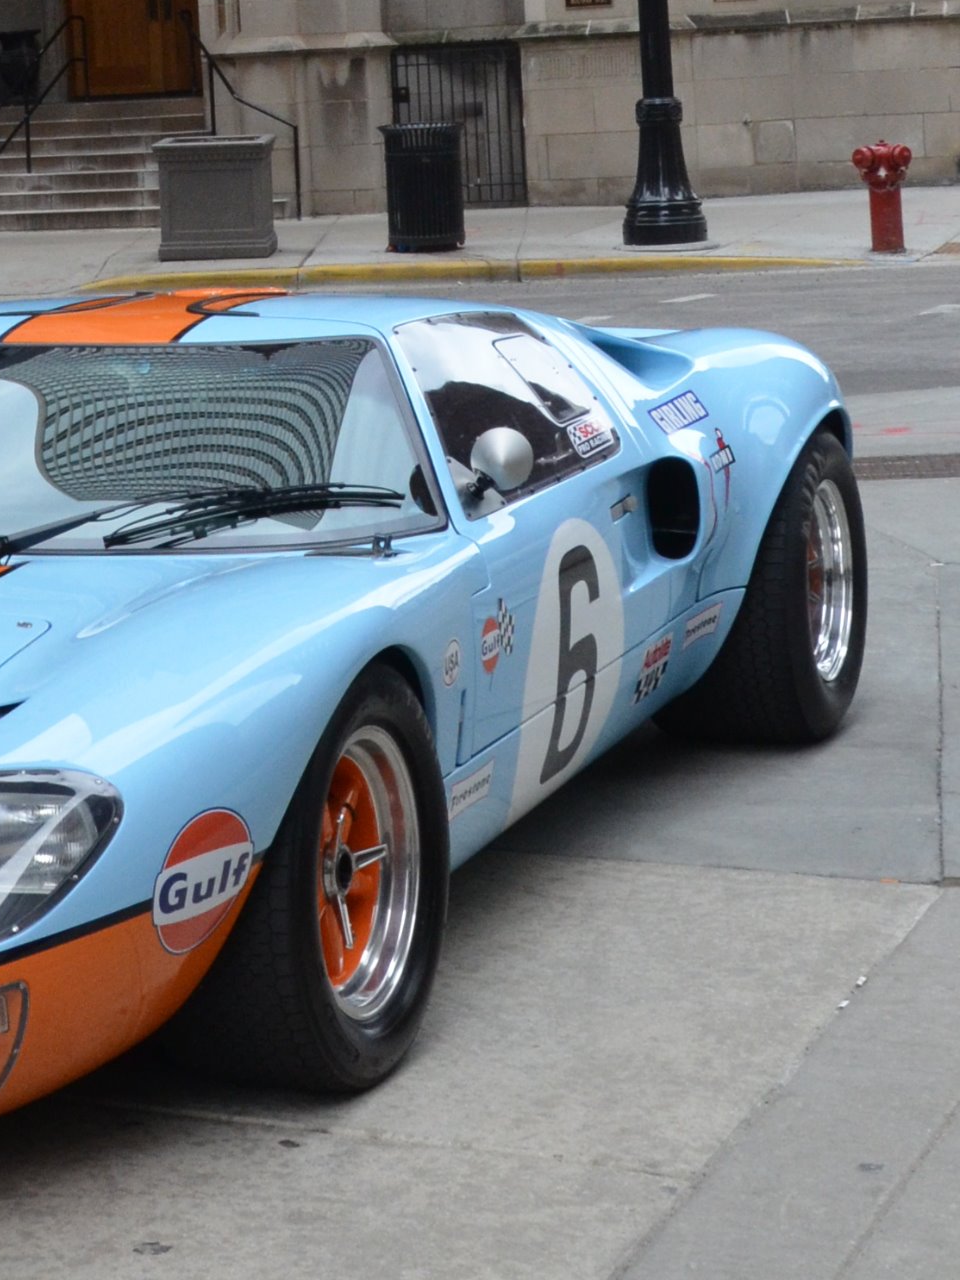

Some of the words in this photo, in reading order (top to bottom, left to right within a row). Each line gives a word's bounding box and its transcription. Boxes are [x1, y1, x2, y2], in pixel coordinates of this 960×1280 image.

[650, 392, 707, 434] GIRLING
[444, 650, 459, 676] USA
[482, 633, 500, 657] Gulf
[539, 544, 600, 785] 6
[158, 851, 250, 915] Gulf
